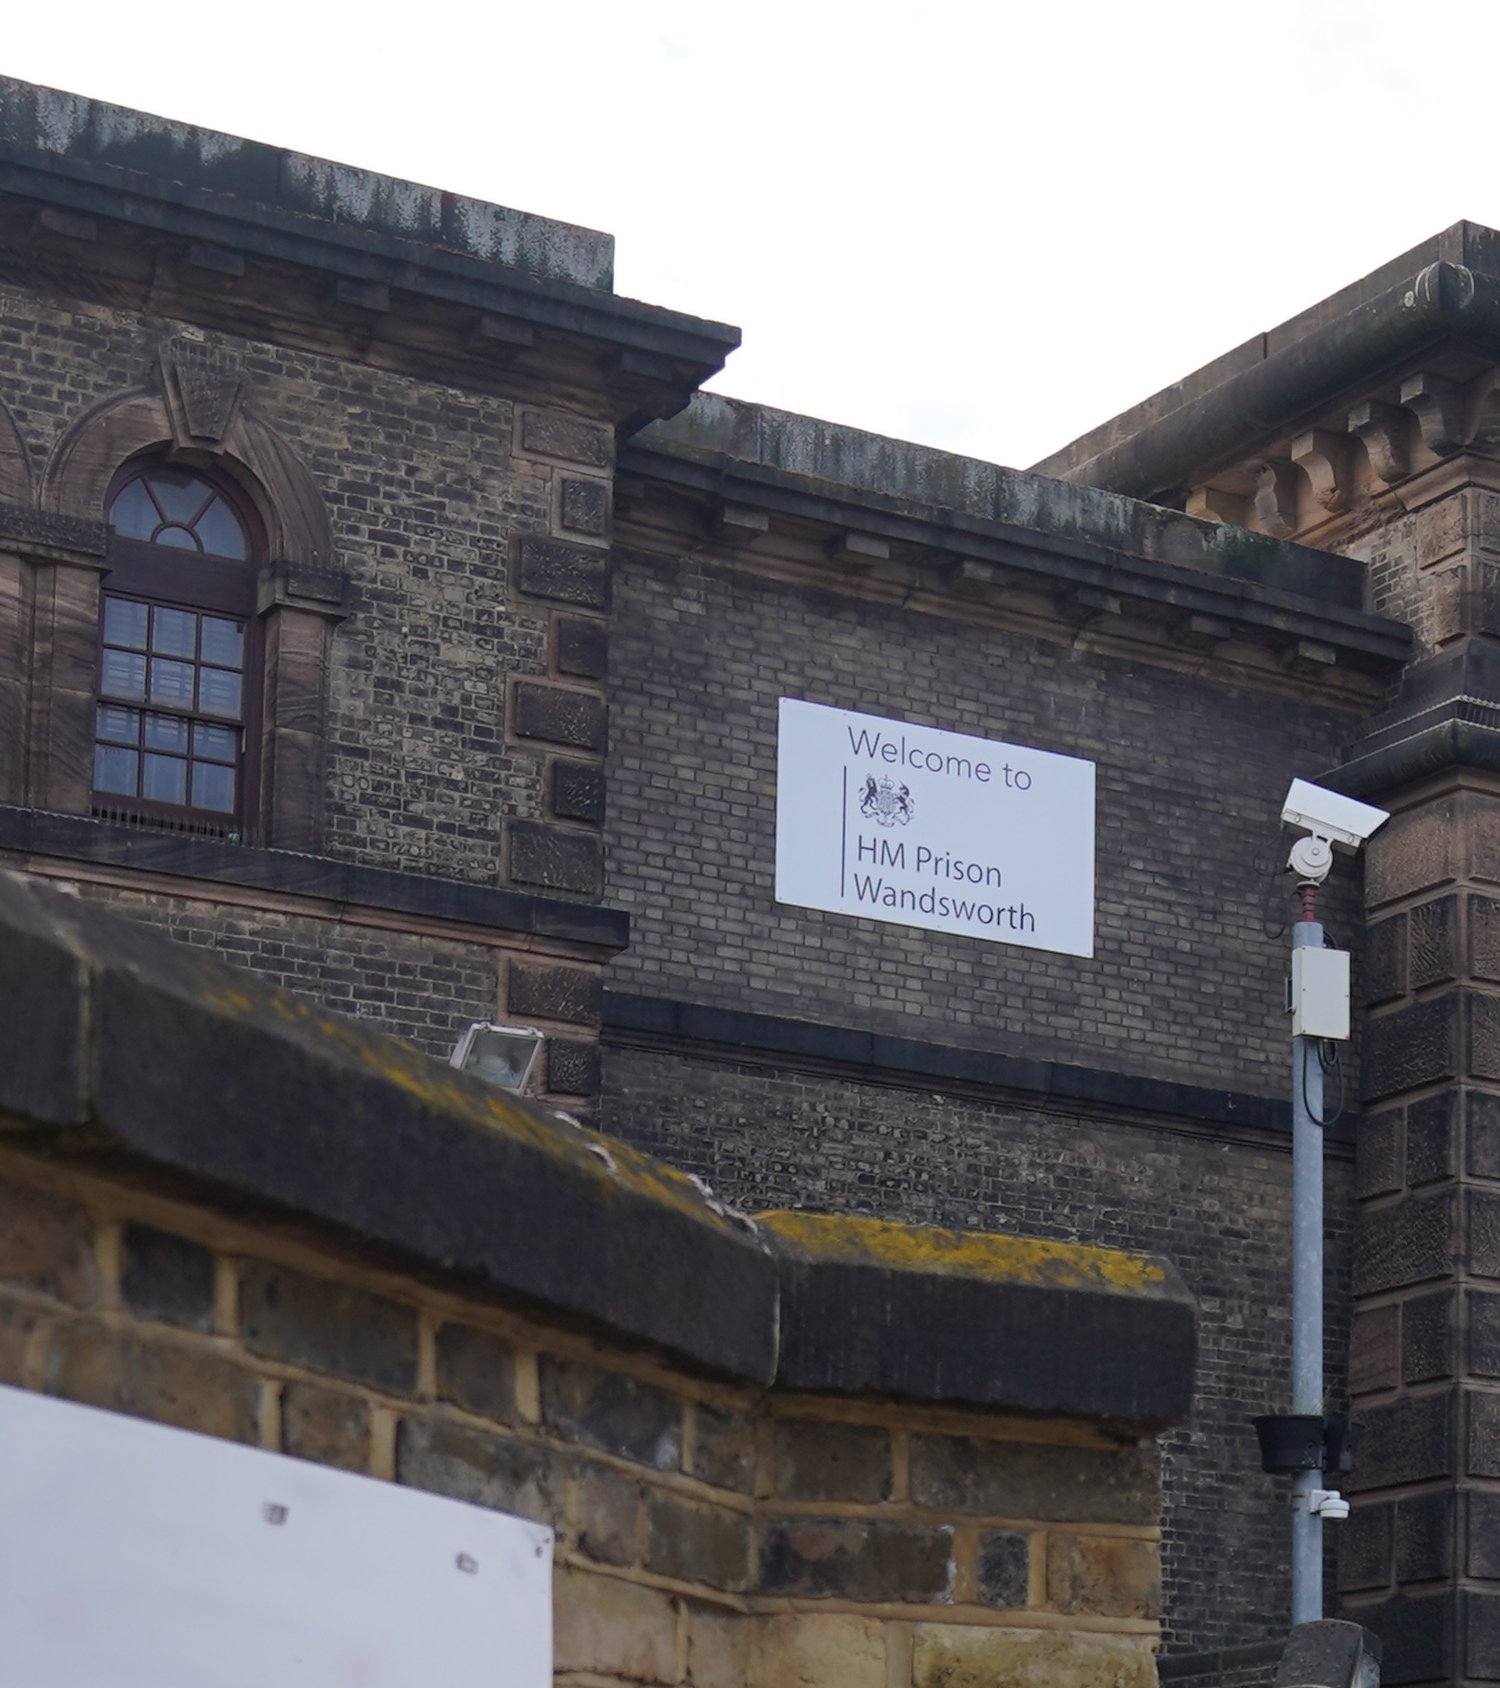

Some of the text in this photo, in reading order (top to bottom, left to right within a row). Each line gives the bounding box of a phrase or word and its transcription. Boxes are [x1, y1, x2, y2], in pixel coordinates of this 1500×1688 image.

[848, 726, 1032, 791] Welcome to
[858, 834, 1002, 888] HM Prison
[854, 873, 1036, 932] Wandsworth
